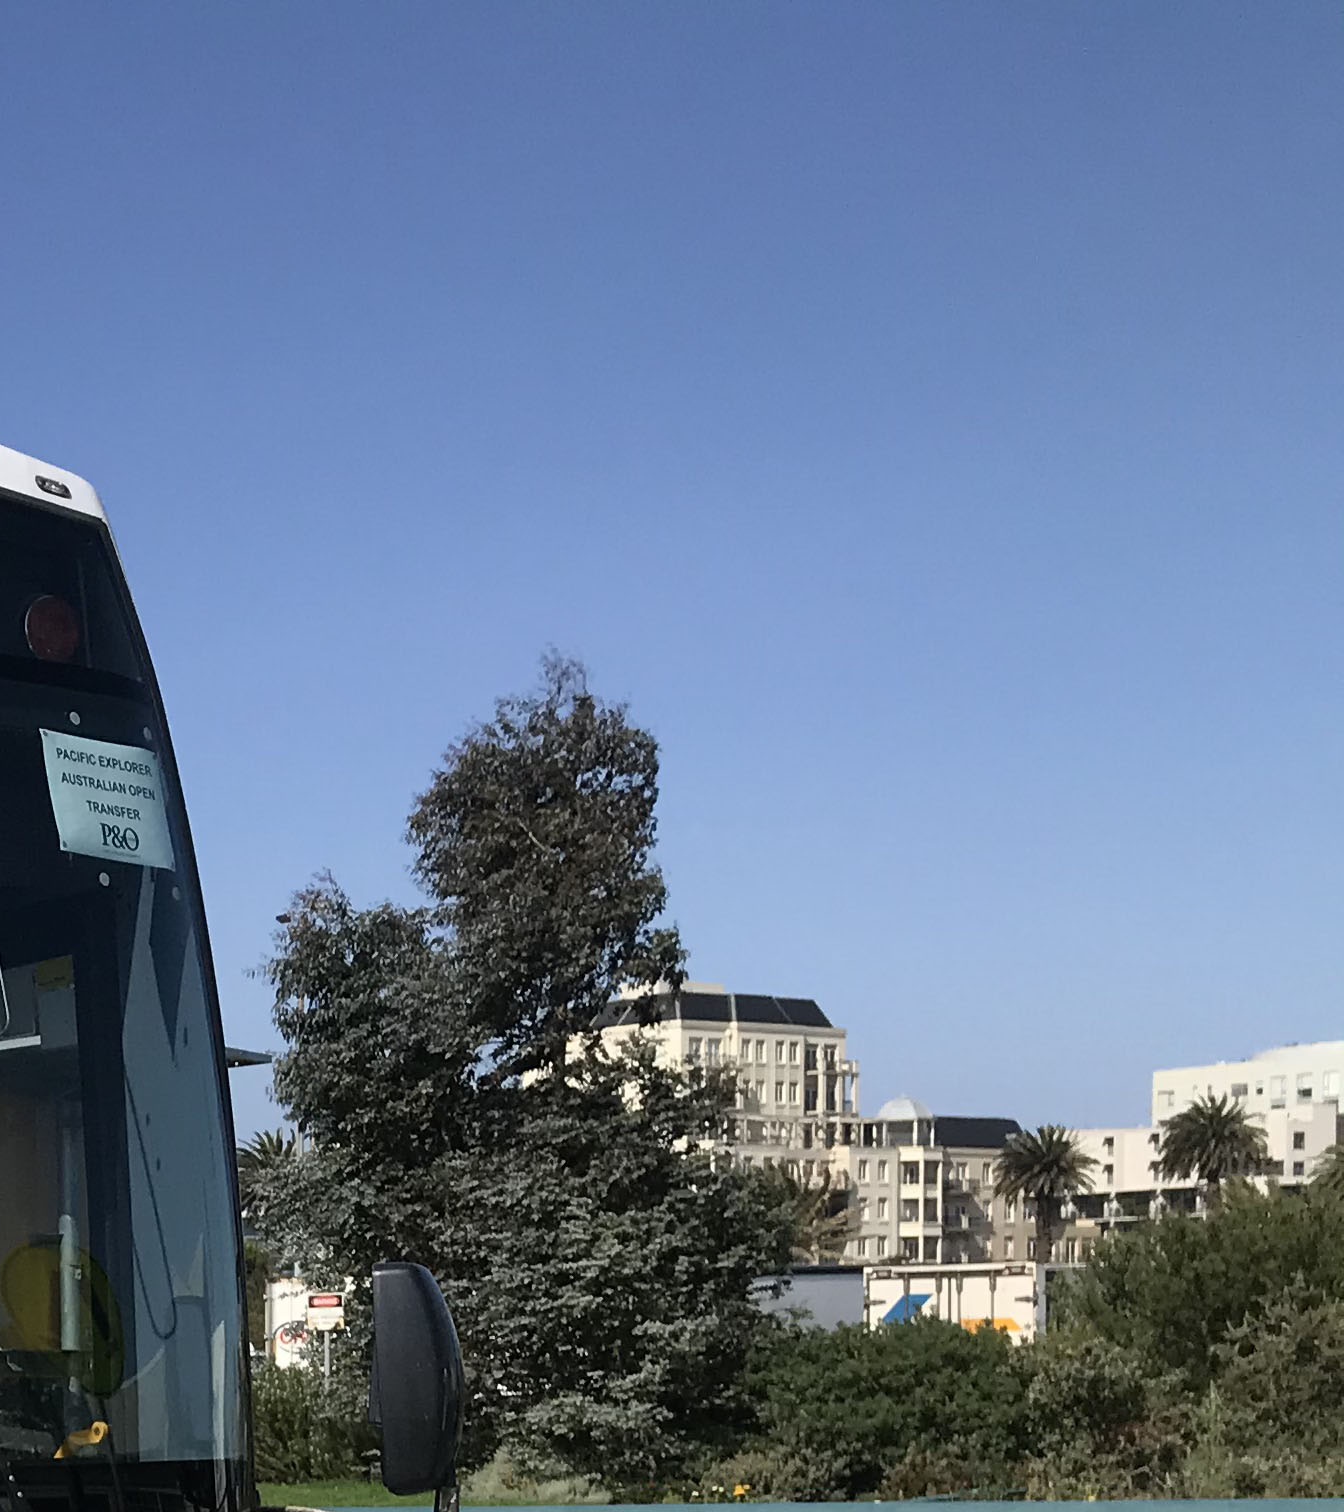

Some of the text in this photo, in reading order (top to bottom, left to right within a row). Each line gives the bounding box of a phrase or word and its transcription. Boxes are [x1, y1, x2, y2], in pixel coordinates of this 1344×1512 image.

[56, 747, 153, 777] PACIFIC EXPLORER
[61, 772, 156, 801] AUSTRALIAN OPEN
[86, 800, 141, 821] TRANSFER
[99, 822, 140, 851] P&O
